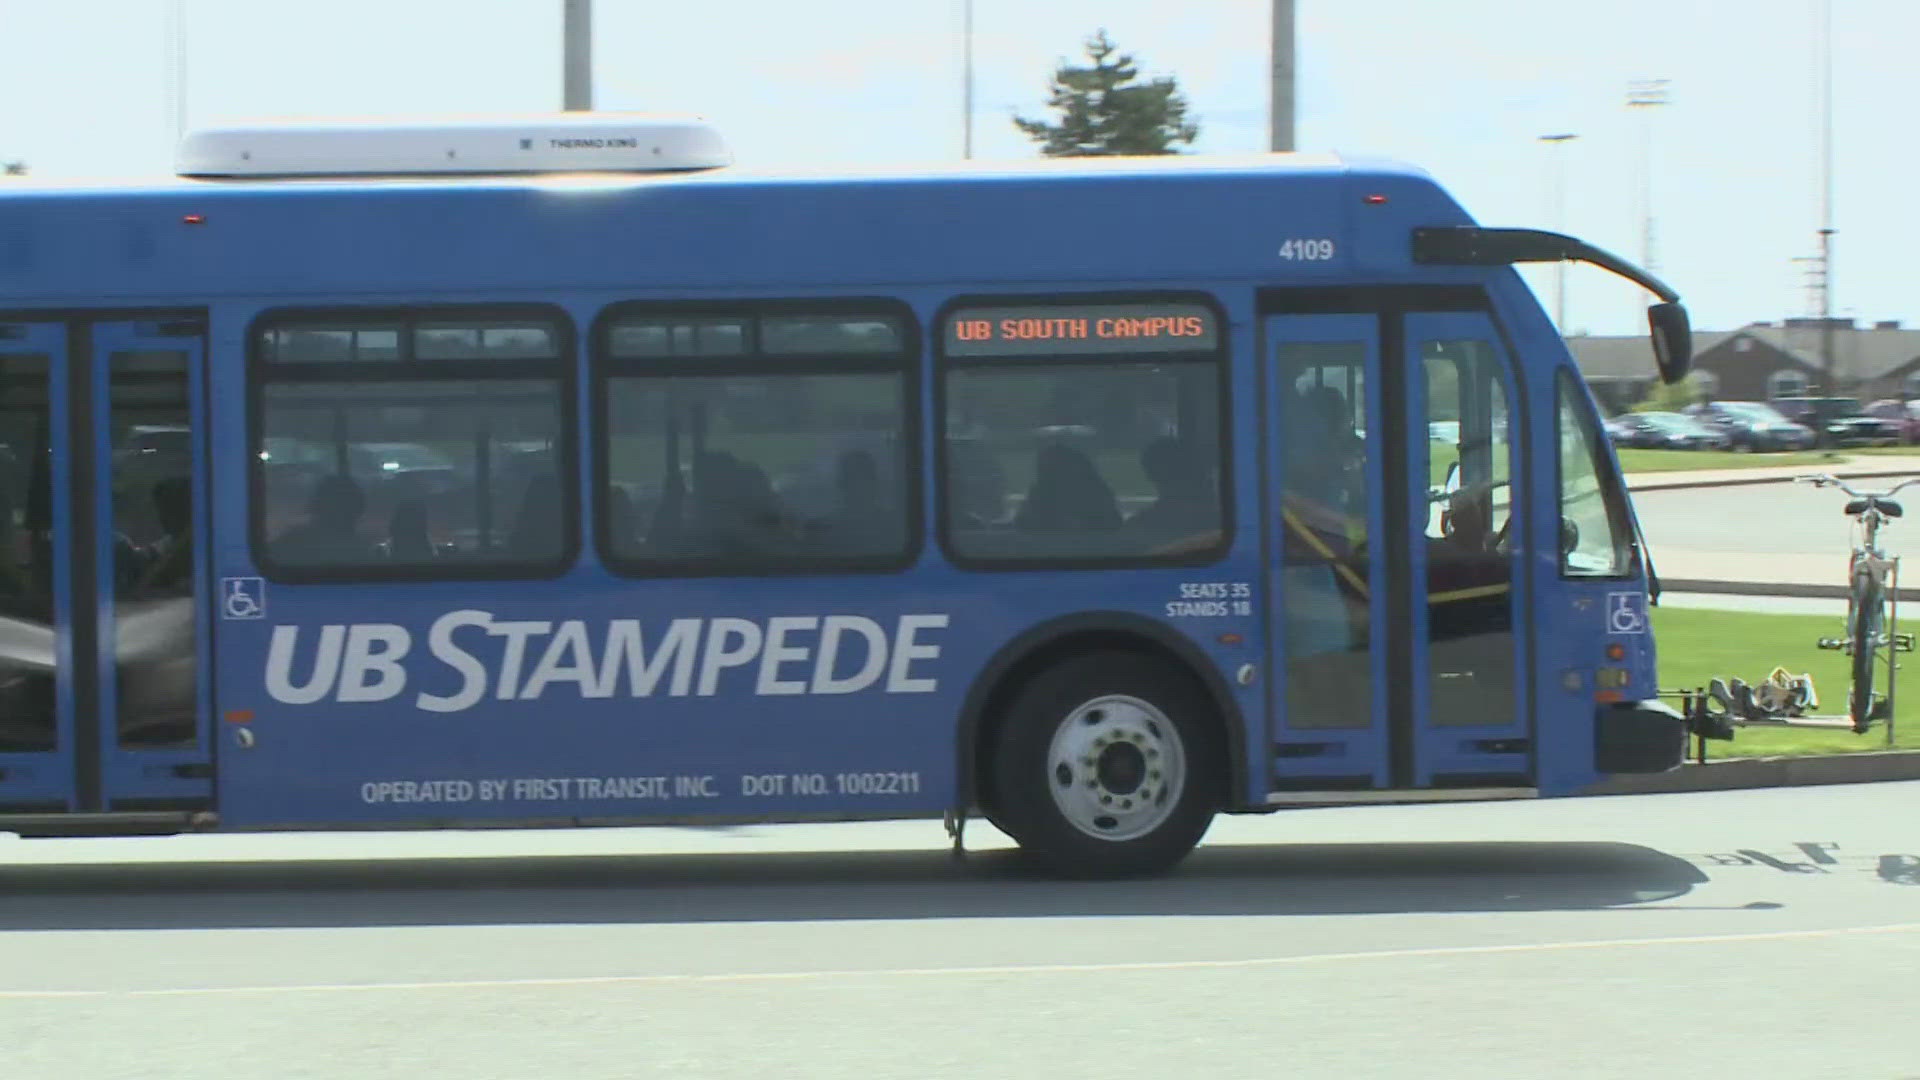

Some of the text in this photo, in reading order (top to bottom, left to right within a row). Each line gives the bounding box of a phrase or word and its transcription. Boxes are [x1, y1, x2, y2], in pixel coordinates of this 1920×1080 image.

[550, 138, 637, 149] THERMO KING
[1279, 240, 1333, 260] 4109
[955, 317, 1203, 340] UB SOUTH CAMPUS
[1180, 583, 1250, 598] SEATS 35
[1165, 601, 1250, 617] STANDS 18
[264, 608, 950, 713] UB STAMPEDE
[361, 771, 921, 804] OPERATED BY FIRST TRANSIT, INC. DOT NO. 1002211
